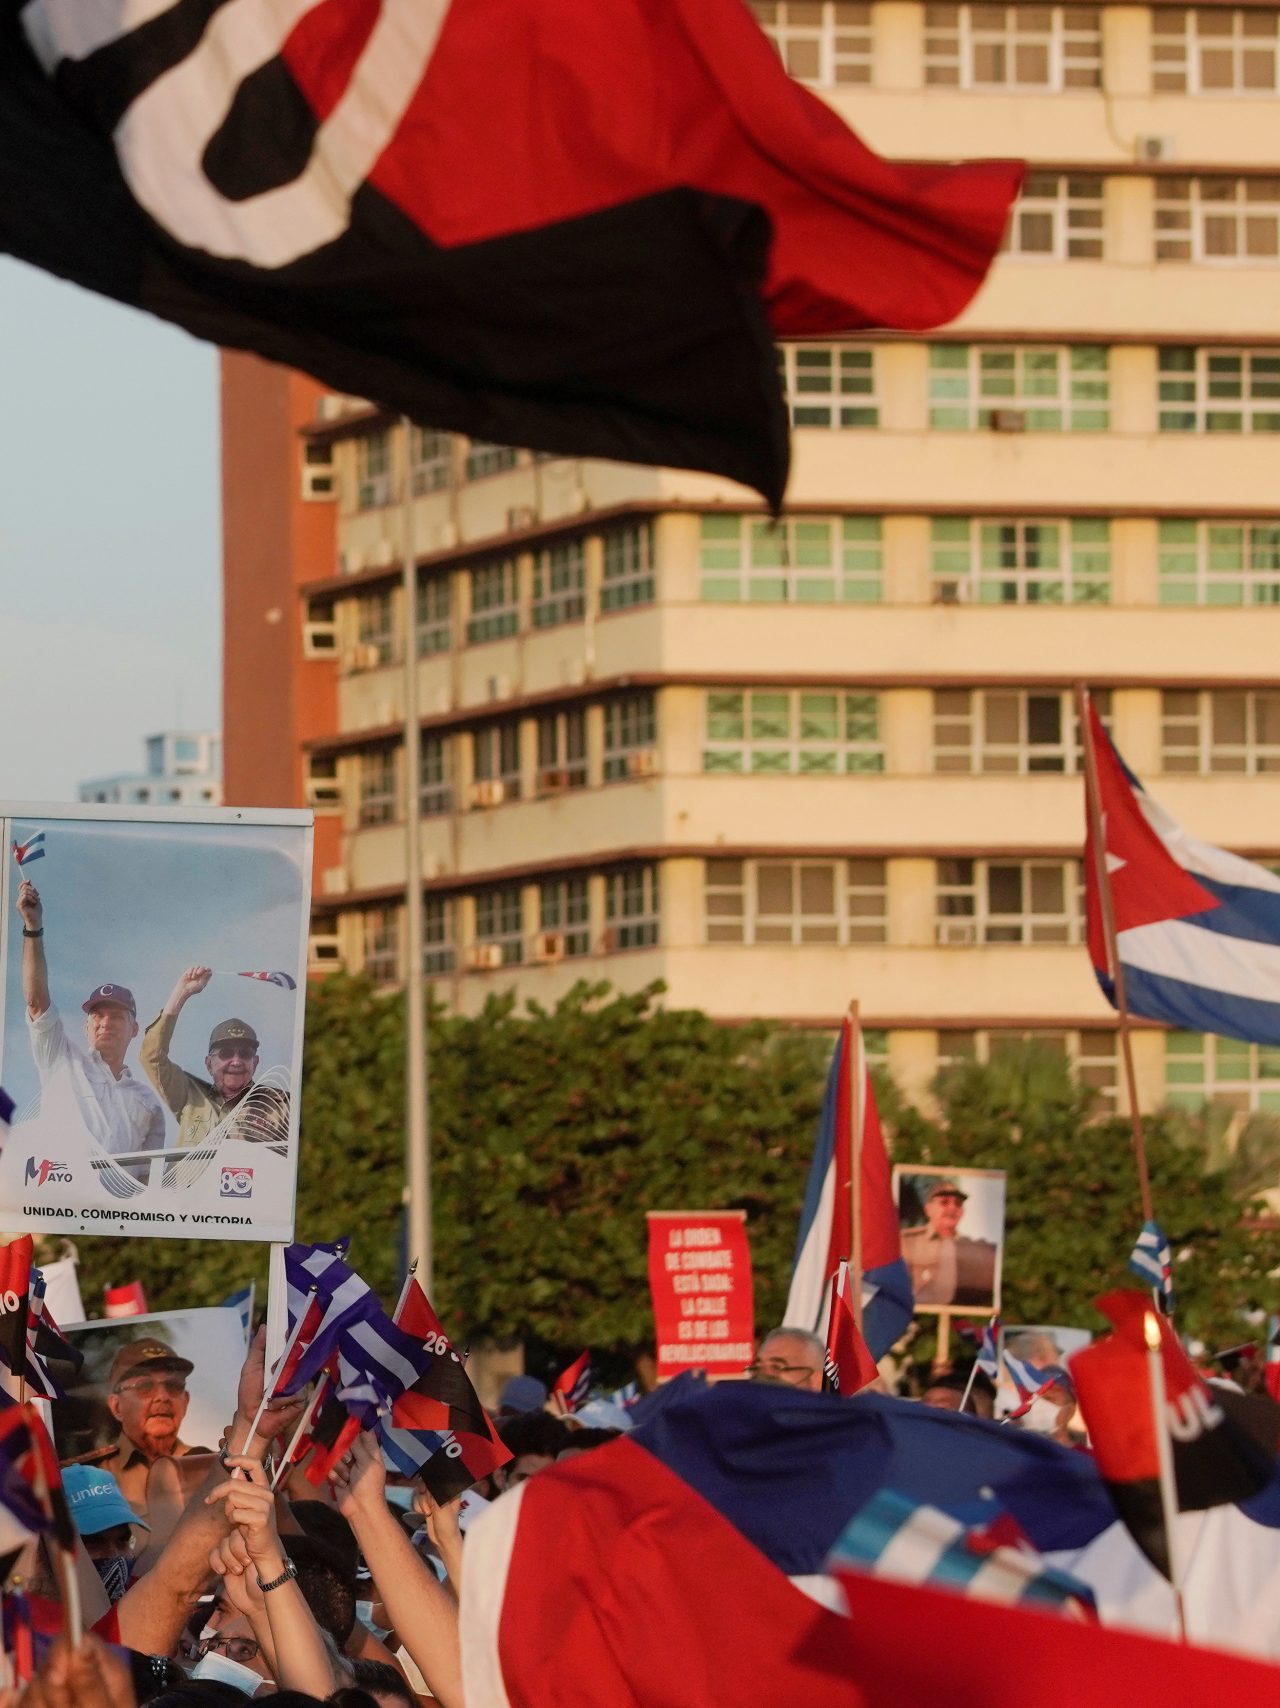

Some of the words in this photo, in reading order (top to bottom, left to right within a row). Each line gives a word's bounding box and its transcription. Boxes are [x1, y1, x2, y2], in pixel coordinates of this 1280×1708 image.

[81, 1208, 176, 1222] COMPROMISO
[179, 1213, 188, 1222] Y
[192, 1214, 253, 1224] VICTORIA
[423, 1331, 448, 1356] 26
